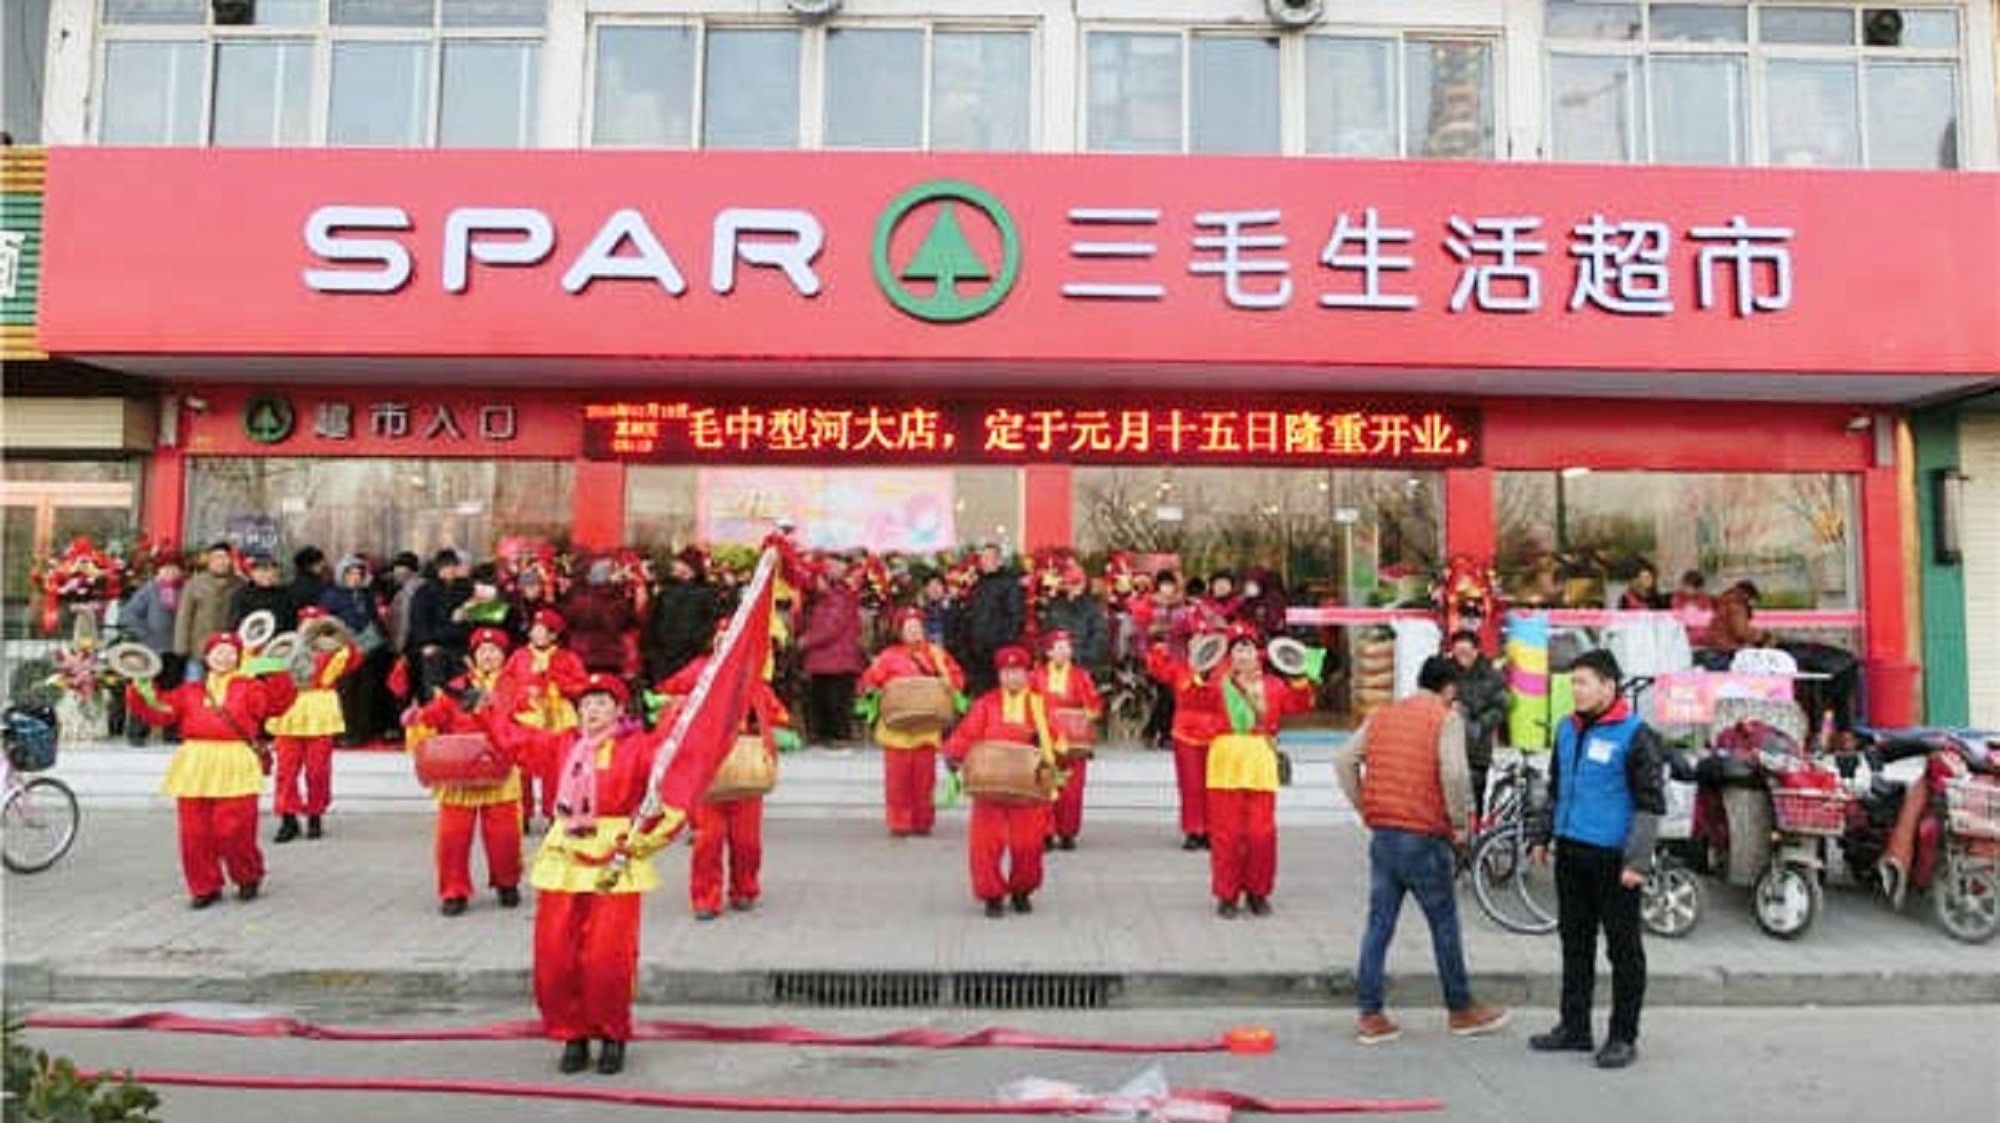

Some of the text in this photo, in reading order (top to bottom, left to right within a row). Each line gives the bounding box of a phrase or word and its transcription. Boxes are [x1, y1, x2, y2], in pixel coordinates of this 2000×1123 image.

[303, 204, 824, 297] SPAR
[1061, 207, 1796, 317] 三毛生活超市
[314, 402, 517, 441] 超市入口
